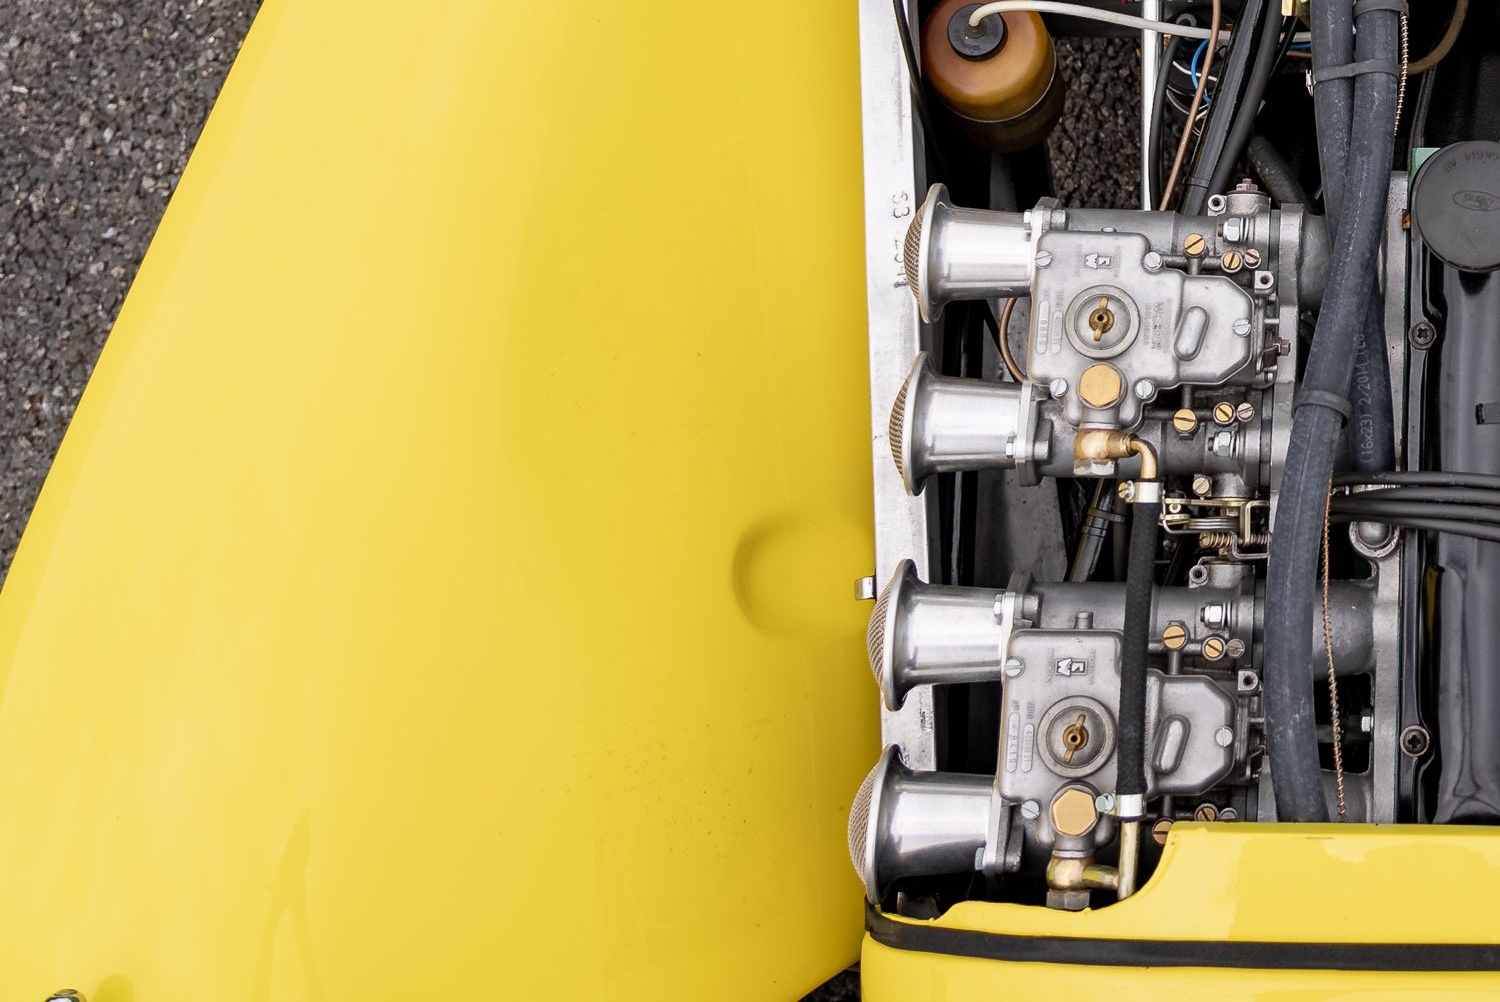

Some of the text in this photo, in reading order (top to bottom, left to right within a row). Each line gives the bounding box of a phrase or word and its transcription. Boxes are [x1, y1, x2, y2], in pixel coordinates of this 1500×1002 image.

[1151, 301, 1165, 350] WEBER
[1356, 362, 1371, 405] 2/2014
[1359, 413, 1373, 463] (16x23)
